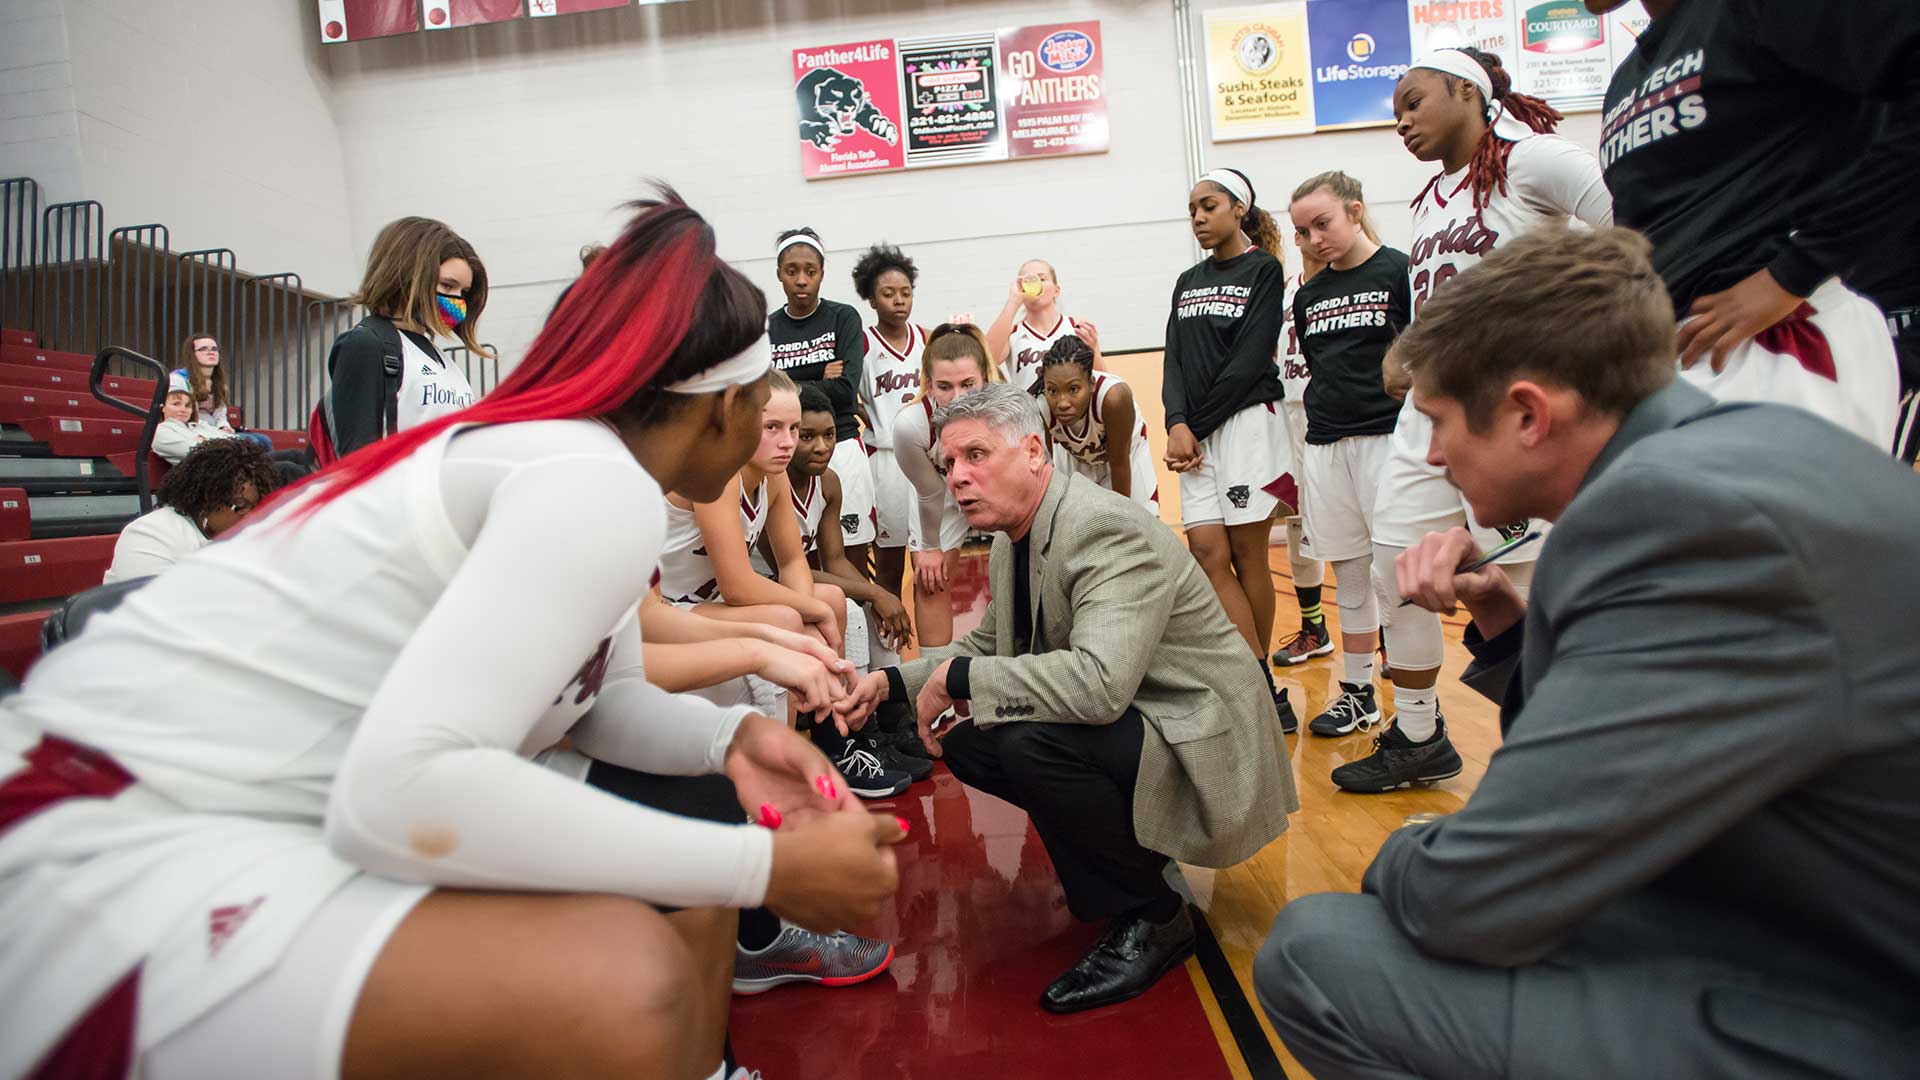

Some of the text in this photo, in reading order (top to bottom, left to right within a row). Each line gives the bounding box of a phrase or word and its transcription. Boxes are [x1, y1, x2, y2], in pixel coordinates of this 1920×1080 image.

[1414, 0, 1503, 25] HOOTERS
[1528, 19, 1598, 33] COURTYARD
[797, 43, 890, 69] Panther4Life
[1008, 50, 1036, 78] GO
[1640, 47, 1704, 98] TECH
[934, 84, 967, 93] PIZZA
[1218, 77, 1304, 93] Sushi, Steaks
[1225, 91, 1297, 106] & Seafood
[1037, 115, 1062, 126] PALM
[1600, 94, 1707, 170] NTHERS
[831, 149, 876, 163] Florida Tech
[1180, 285, 1252, 300] FLORIDA TECH
[1177, 302, 1245, 320] PANTHERS
[1305, 295, 1350, 318] FLORIDA
[1352, 291, 1389, 304] TECH
[811, 331, 836, 347] TECH
[1284, 358, 1312, 379] Tec
[873, 368, 921, 398] Flori
[421, 382, 466, 409] Floria
